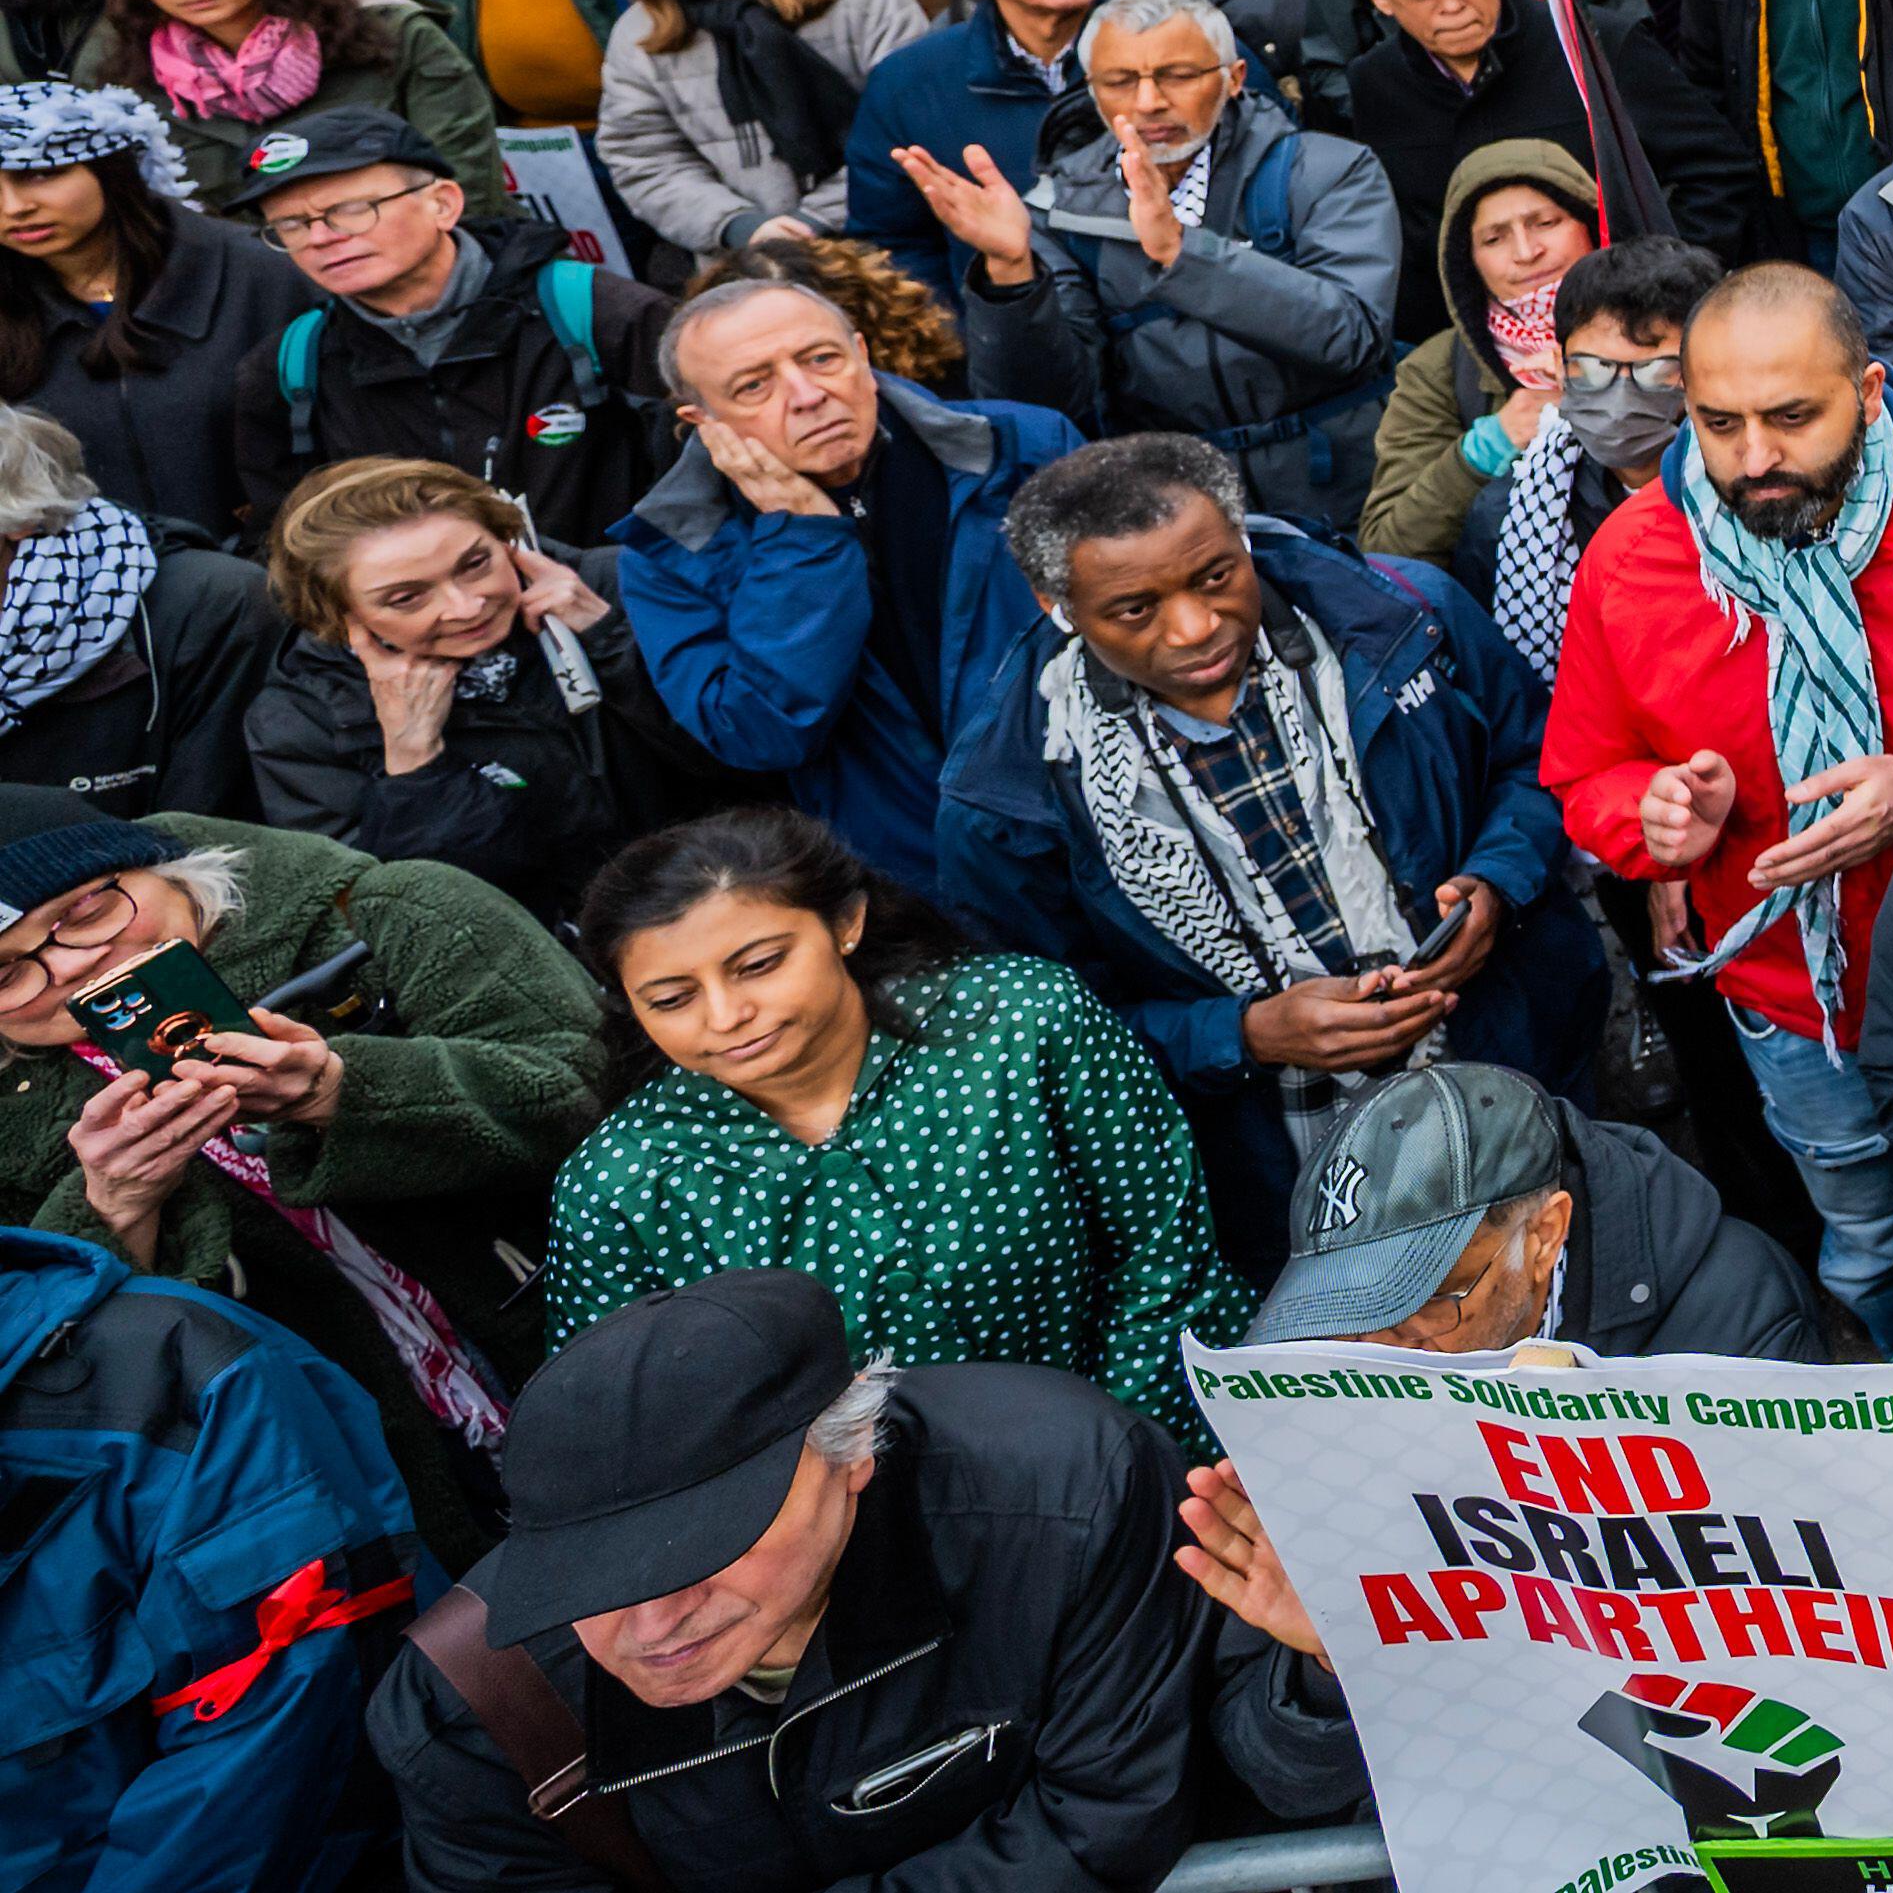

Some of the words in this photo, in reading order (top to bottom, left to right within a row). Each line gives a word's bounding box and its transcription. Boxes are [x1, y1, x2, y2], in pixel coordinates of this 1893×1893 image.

[1193, 1364, 1434, 1402] Palestine
[1449, 1374, 1671, 1426] Solidarity
[1475, 1419, 1712, 1514] END
[1412, 1492, 1845, 1591] ISRAELI
